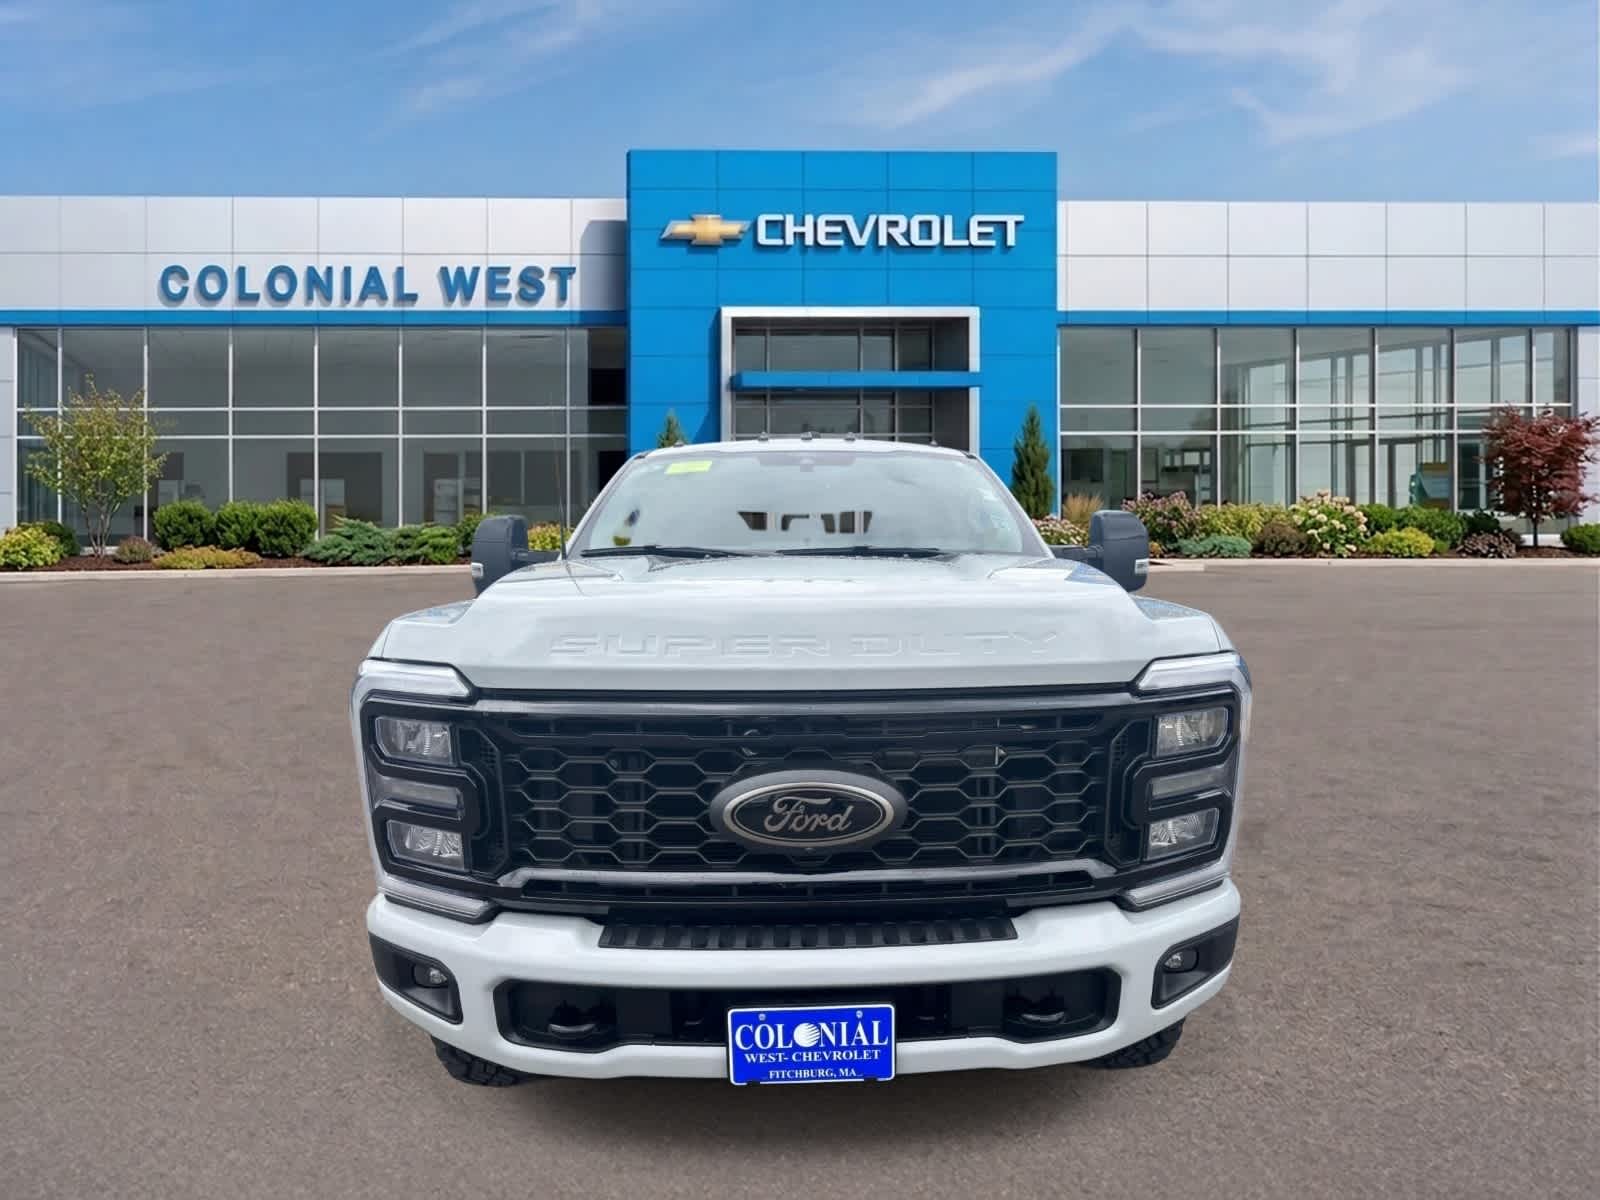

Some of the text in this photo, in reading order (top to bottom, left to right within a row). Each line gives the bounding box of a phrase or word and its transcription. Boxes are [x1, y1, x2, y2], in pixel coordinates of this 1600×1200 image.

[756, 213, 1025, 247] CHEVROLET
[159, 264, 577, 306] COLONIAL WEST
[549, 632, 832, 657] SUPER
[763, 796, 854, 832] Ford
[735, 1020, 889, 1050] COLONIAL
[792, 1050, 881, 1062] CHEVROLET
[769, 1067, 857, 1079] FITCHBURG, MA
